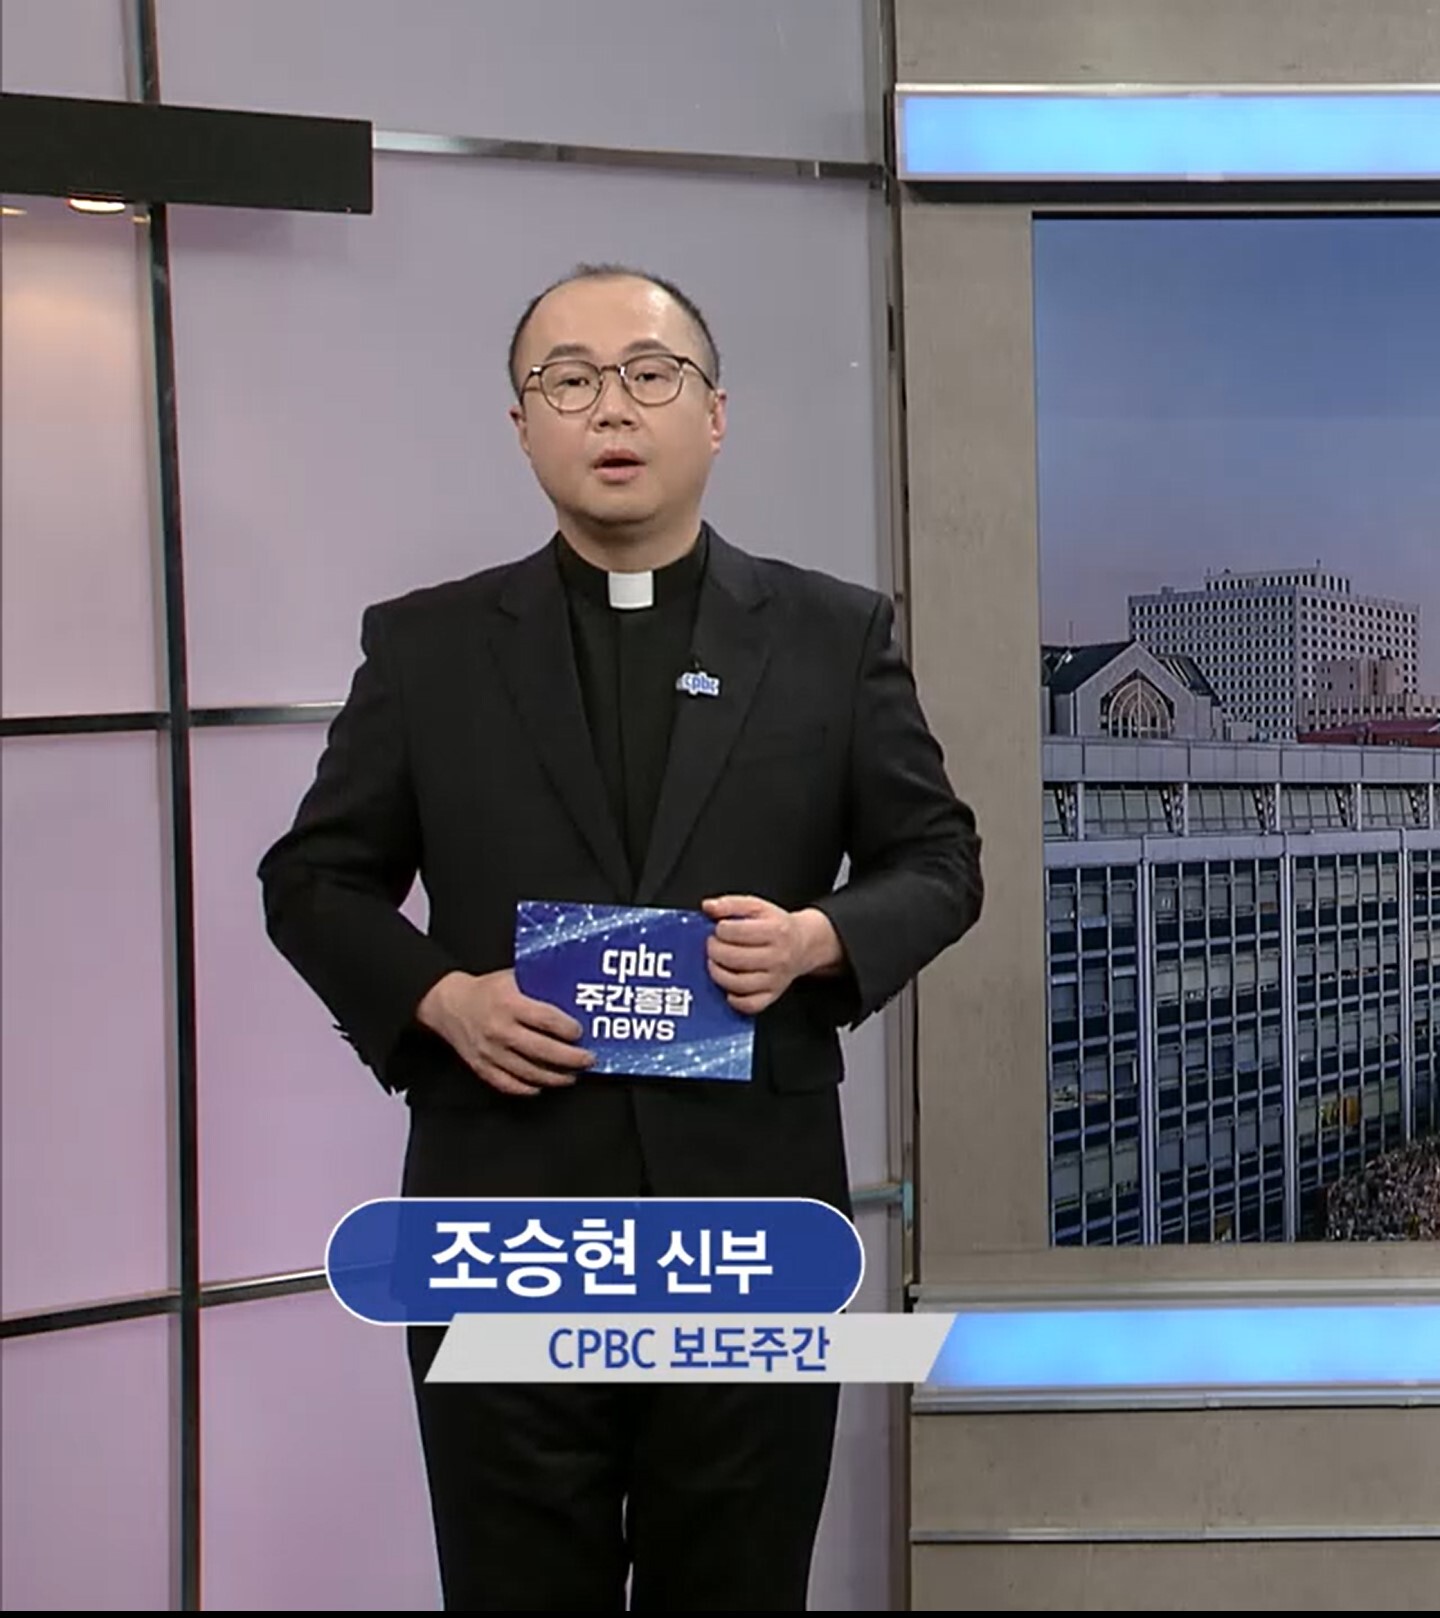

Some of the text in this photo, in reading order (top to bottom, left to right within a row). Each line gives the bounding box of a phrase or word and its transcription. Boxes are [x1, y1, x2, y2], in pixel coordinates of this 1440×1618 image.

[602, 943, 673, 983] cpbc
[575, 983, 693, 1016] 주간종합
[591, 1016, 676, 1041] news
